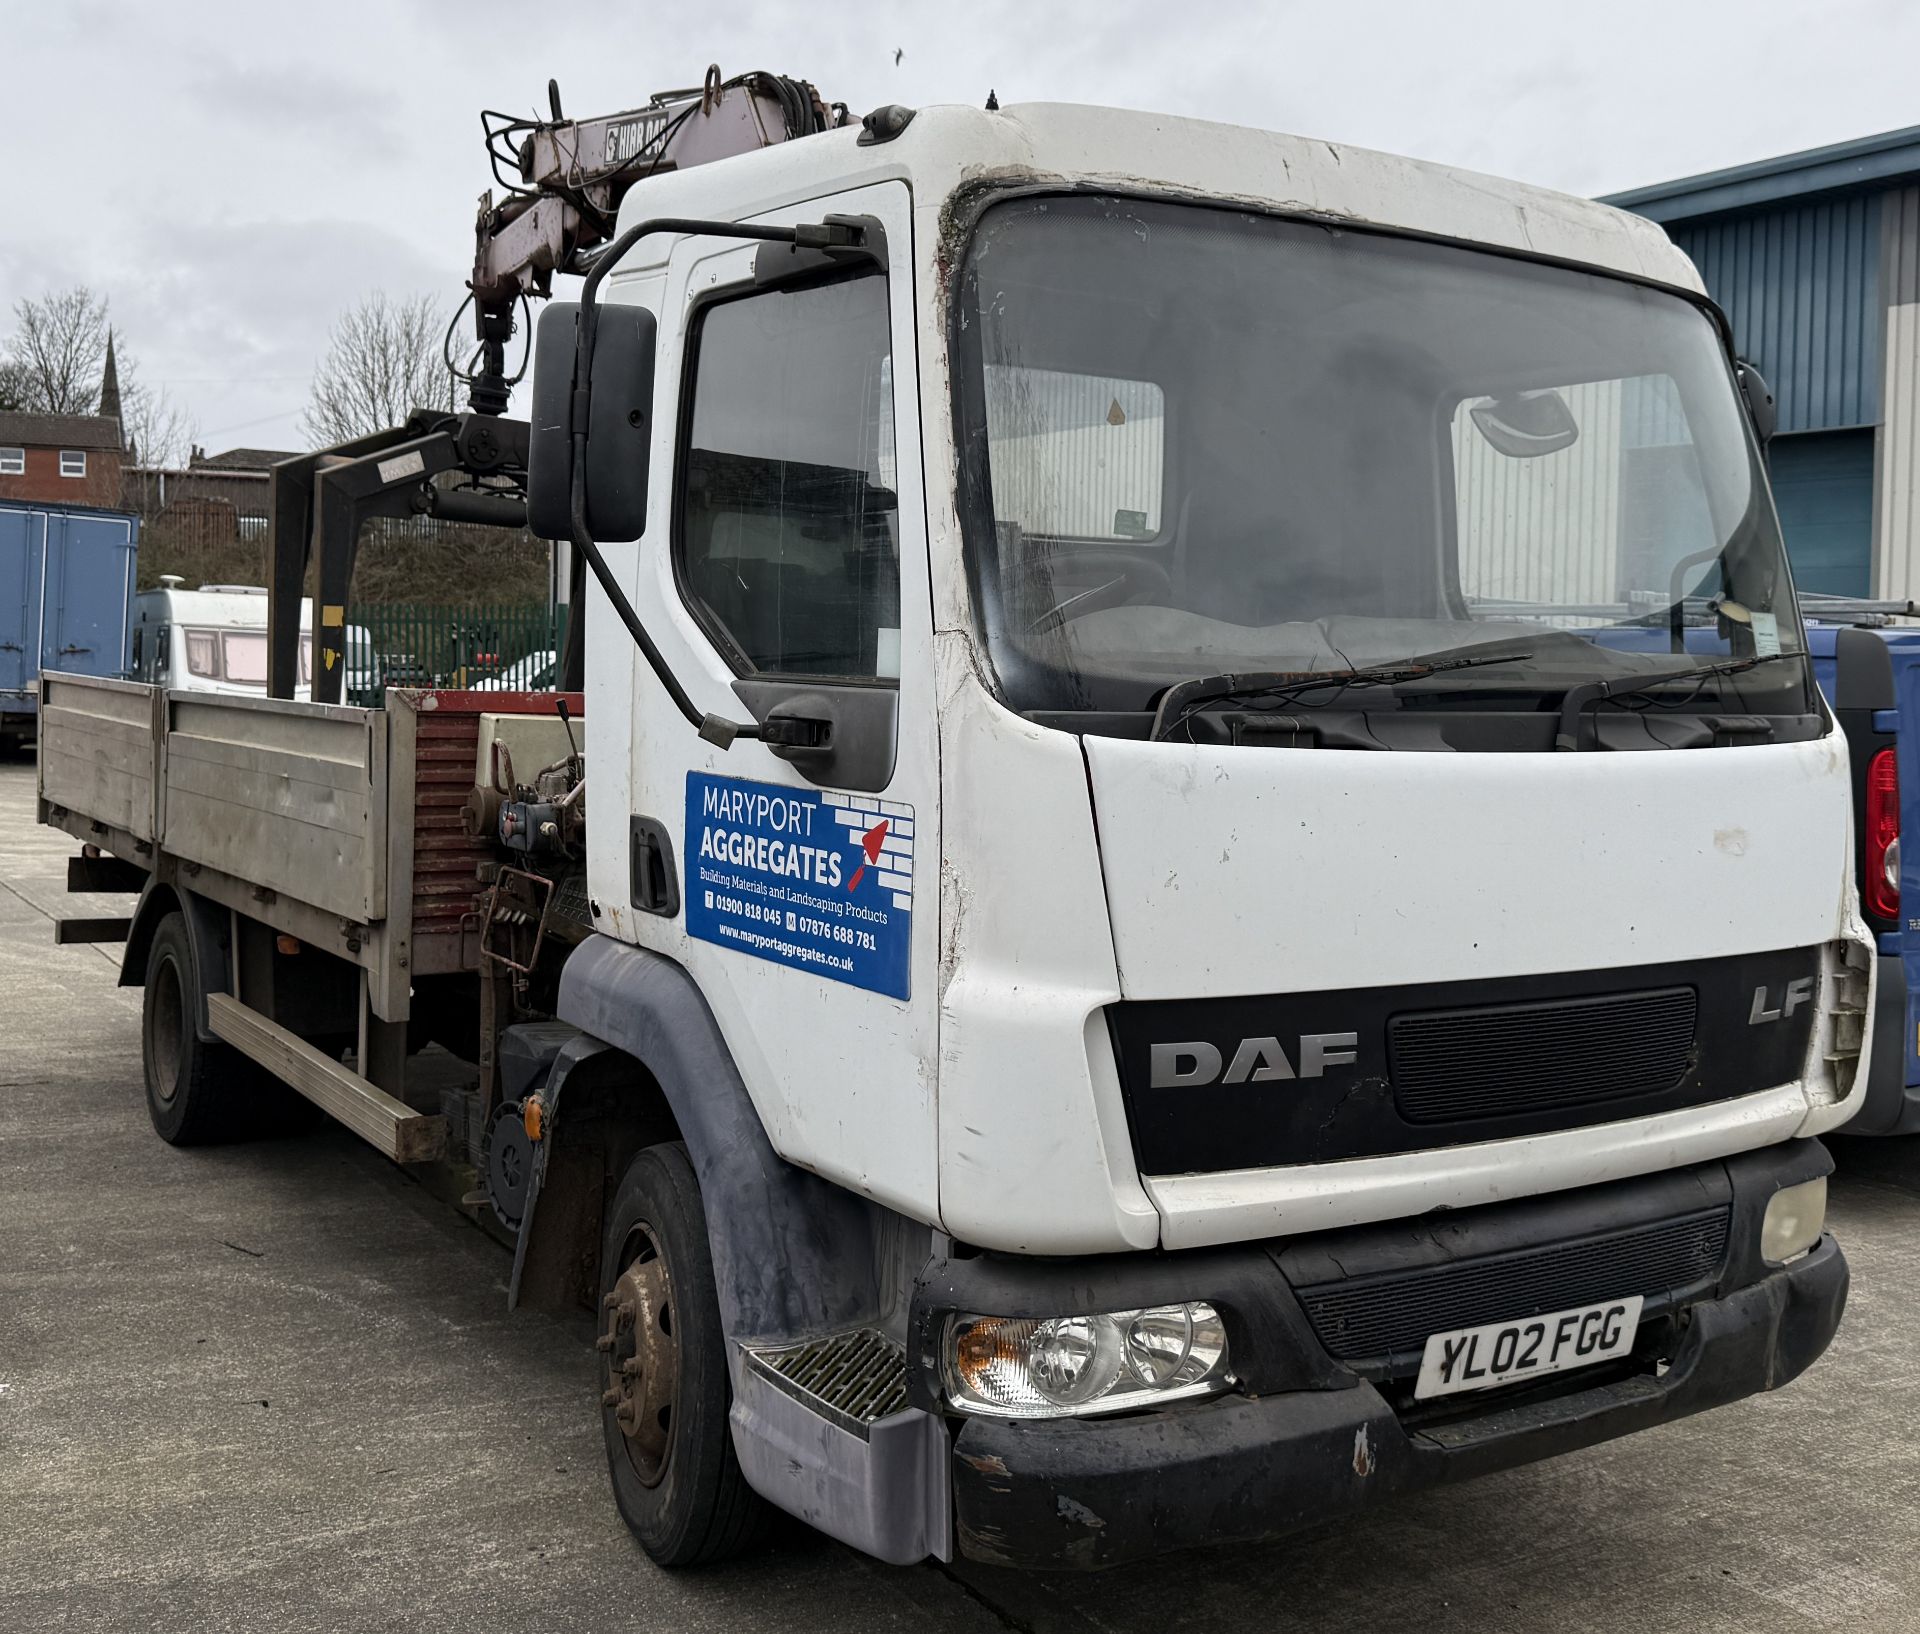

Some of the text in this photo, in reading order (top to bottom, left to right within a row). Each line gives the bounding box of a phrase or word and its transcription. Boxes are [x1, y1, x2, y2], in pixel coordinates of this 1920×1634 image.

[703, 786, 816, 836] MARYPORT
[700, 826, 842, 887] AGGREGATES
[700, 867, 888, 924] Building Materials and Landscaping Products
[716, 895, 743, 915] 01900
[745, 902, 761, 920] 818
[763, 908, 781, 926] 045
[799, 919, 831, 939] 07876
[833, 926, 854, 944] 688
[856, 931, 877, 950] 781
[719, 924, 854, 971] www.maryportaggregates.co.uk
[1748, 975, 1814, 1025] LF
[1150, 1031, 1358, 1088] DAF
[1442, 1305, 1626, 1384] YL02 FGG
